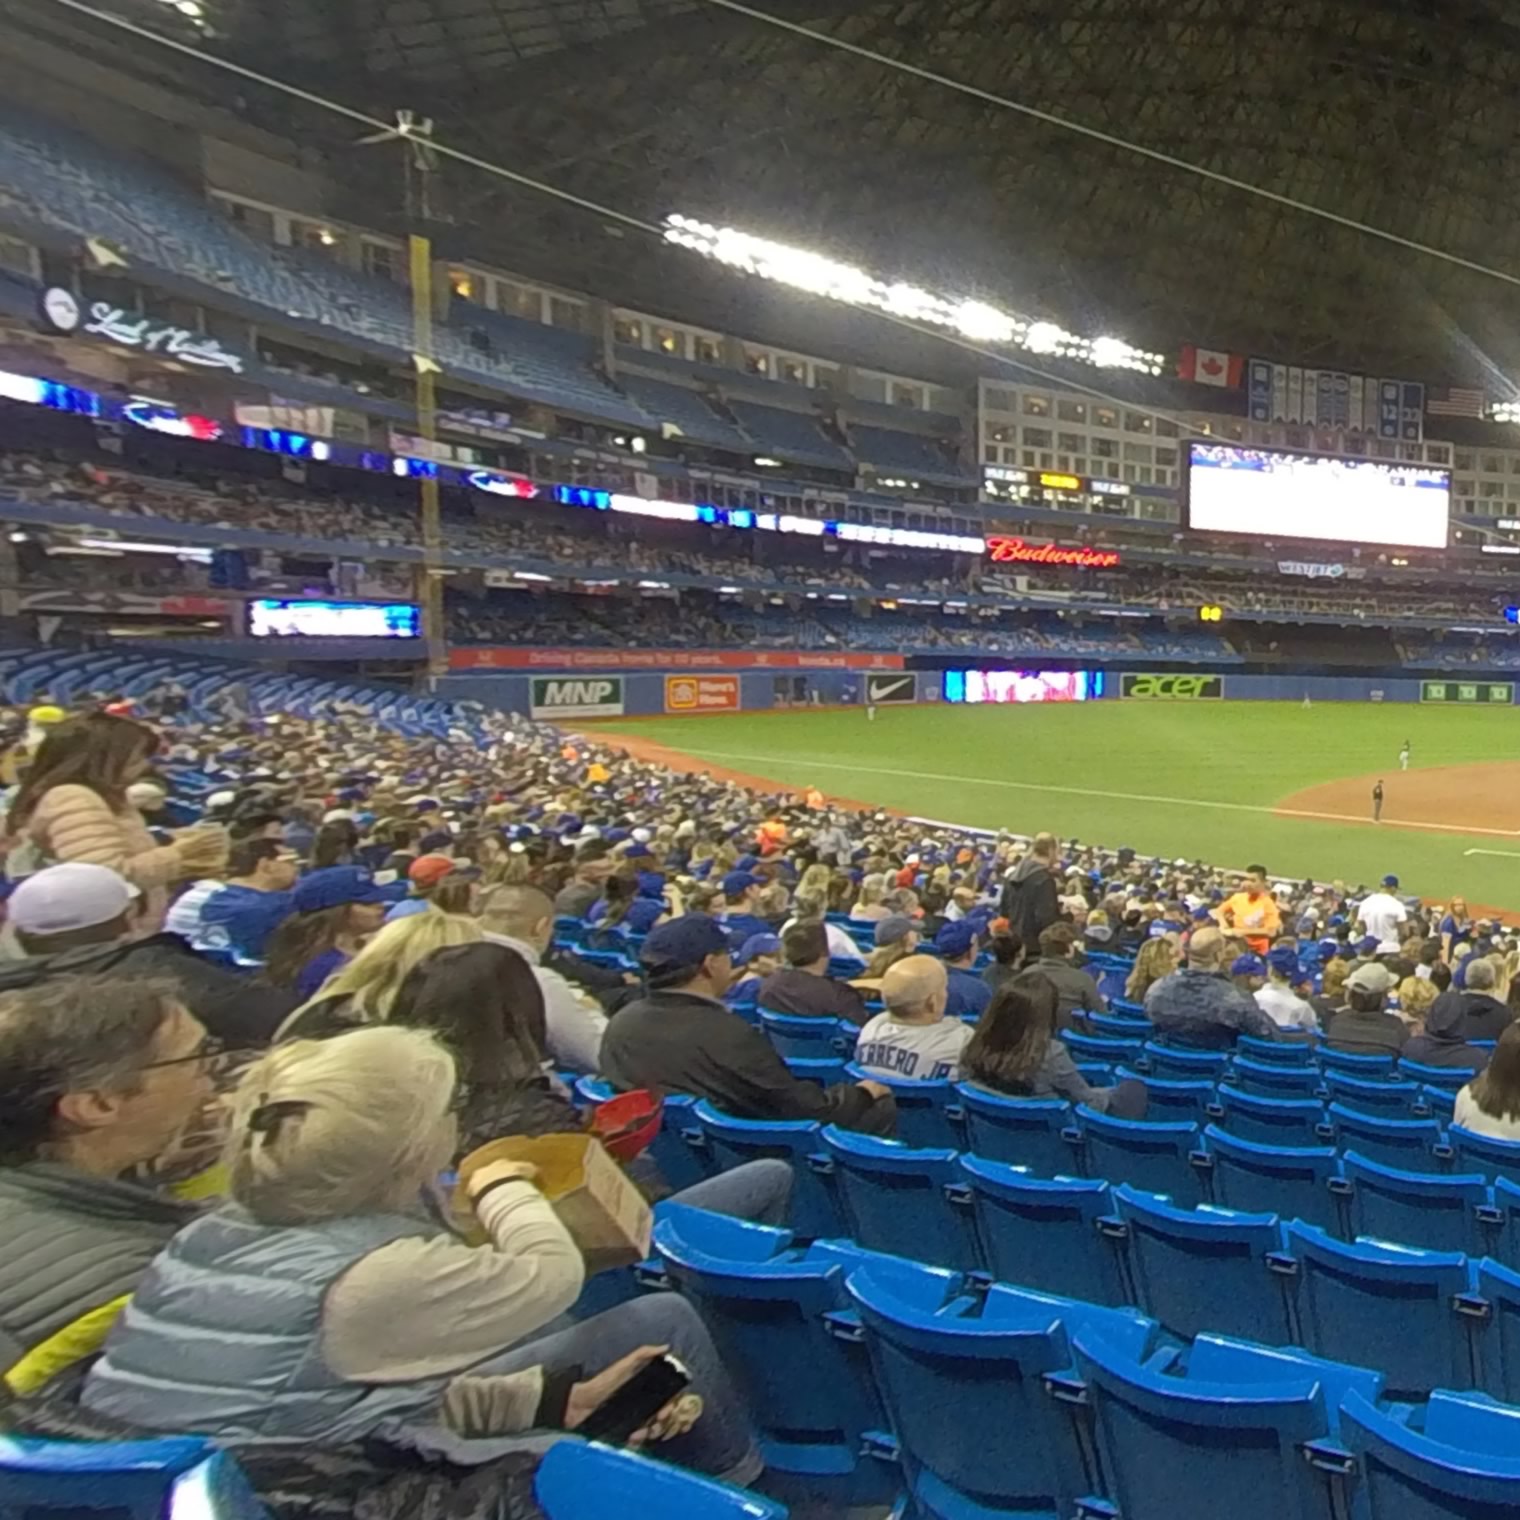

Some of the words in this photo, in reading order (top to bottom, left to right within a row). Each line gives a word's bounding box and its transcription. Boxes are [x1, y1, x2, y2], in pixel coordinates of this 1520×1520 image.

[1382, 405, 1399, 420] 12
[986, 537, 1120, 567] Budweiser
[544, 681, 613, 705] MNP
[1130, 674, 1215, 697] acer
